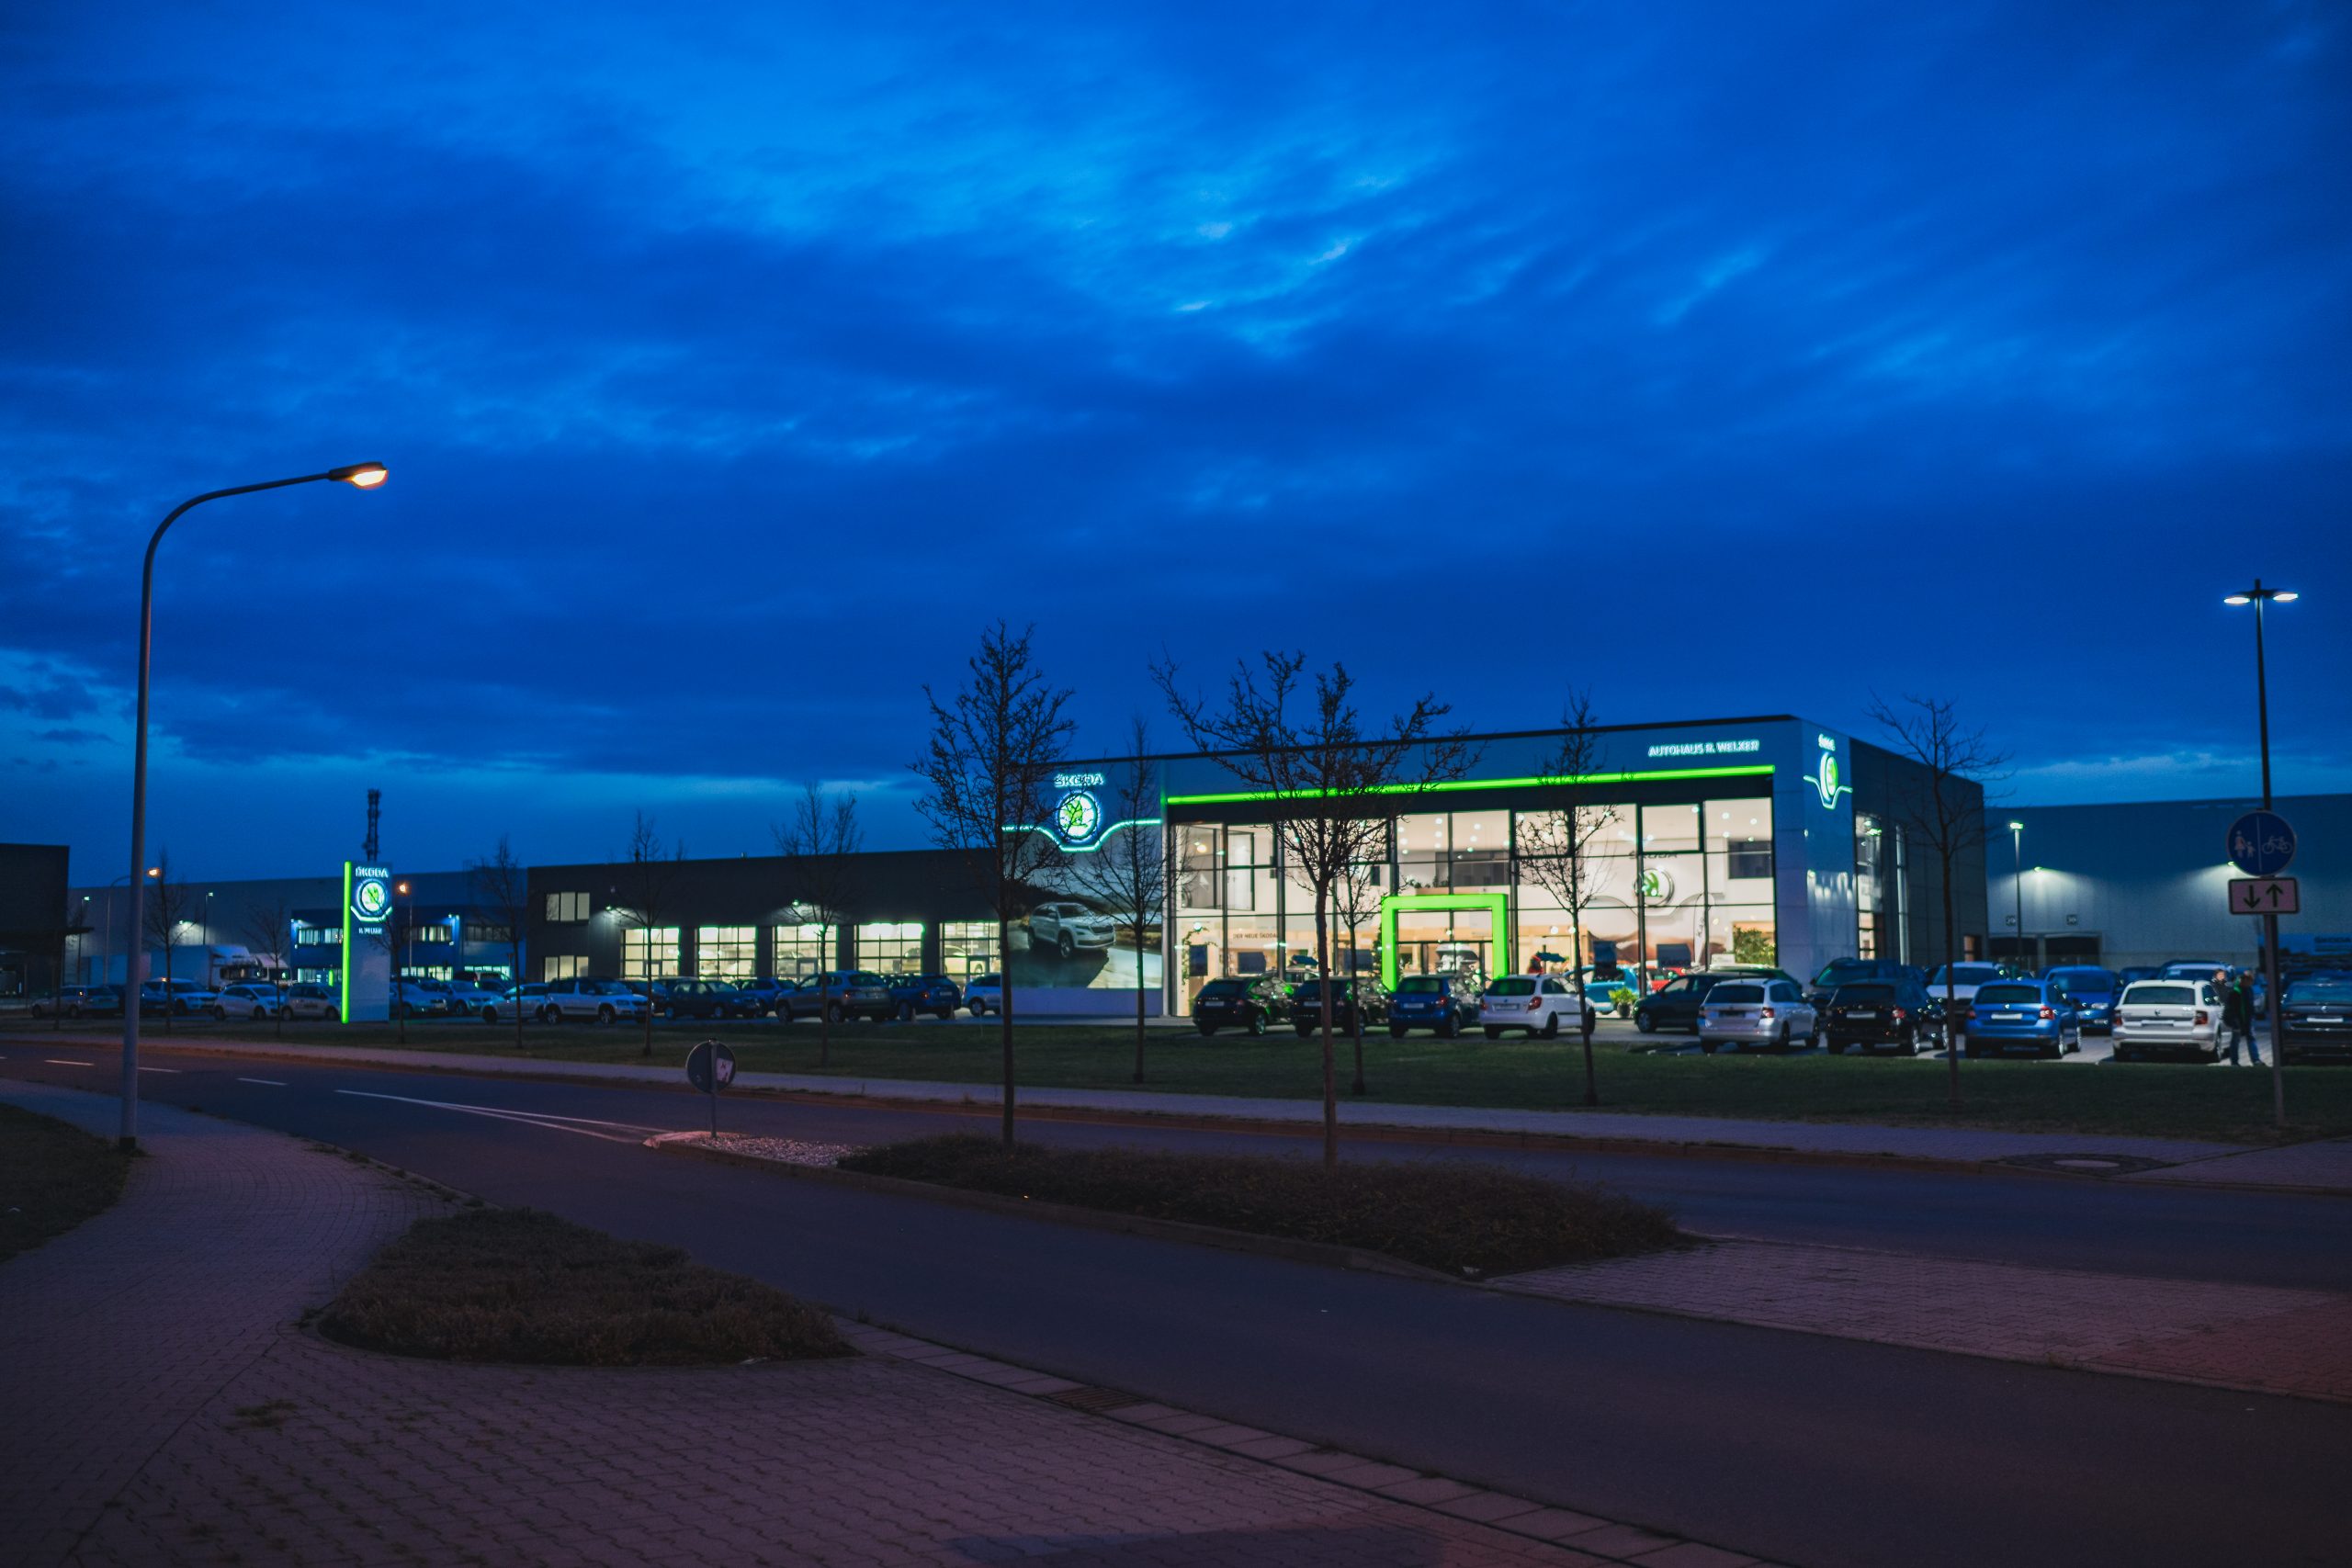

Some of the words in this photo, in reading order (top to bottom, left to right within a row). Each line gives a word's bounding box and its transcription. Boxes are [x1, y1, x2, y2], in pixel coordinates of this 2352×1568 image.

[1648, 742, 1703, 757] AUTOHAUS
[1705, 741, 1715, 754] R.
[1716, 739, 1759, 751] WELKER
